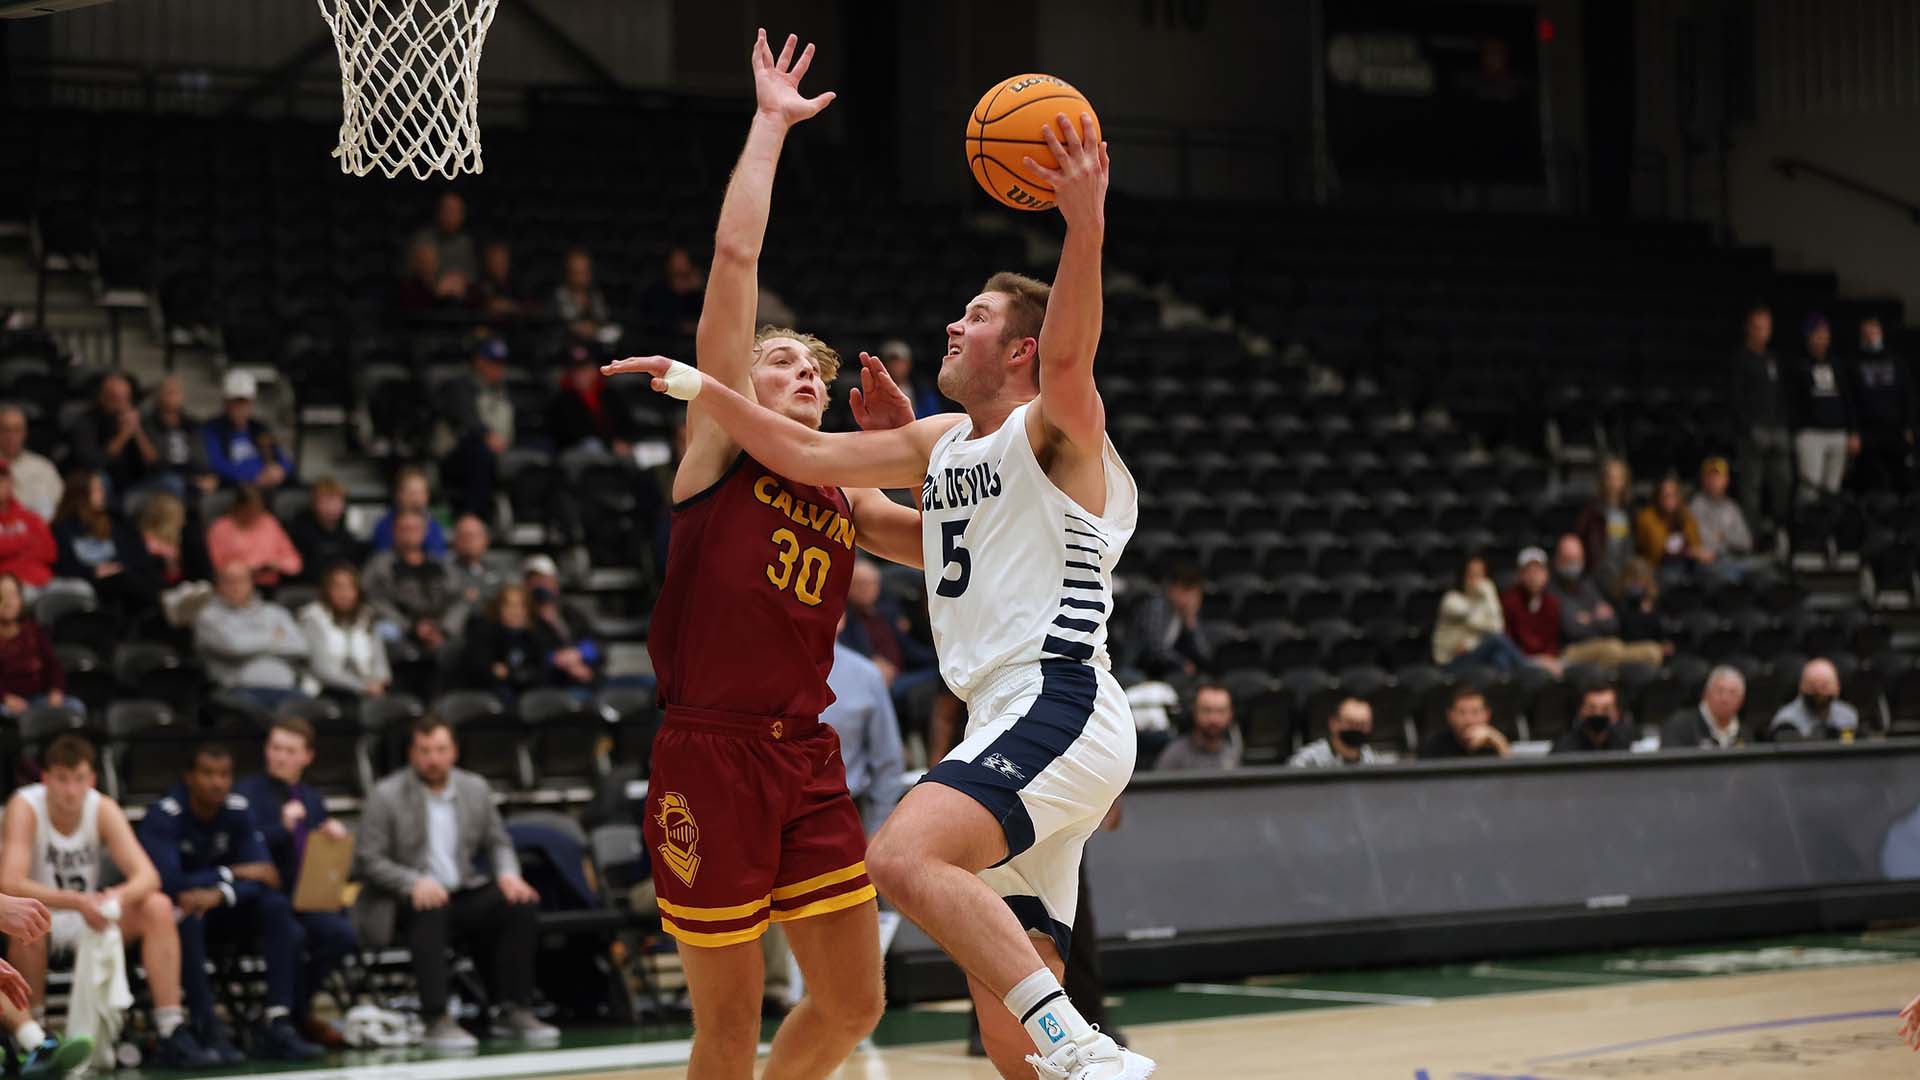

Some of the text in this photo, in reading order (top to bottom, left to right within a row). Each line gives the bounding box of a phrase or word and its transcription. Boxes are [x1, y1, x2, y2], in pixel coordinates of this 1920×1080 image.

[753, 475, 856, 551] CALVIN
[766, 527, 832, 607] 30
[936, 519, 972, 598] 5
